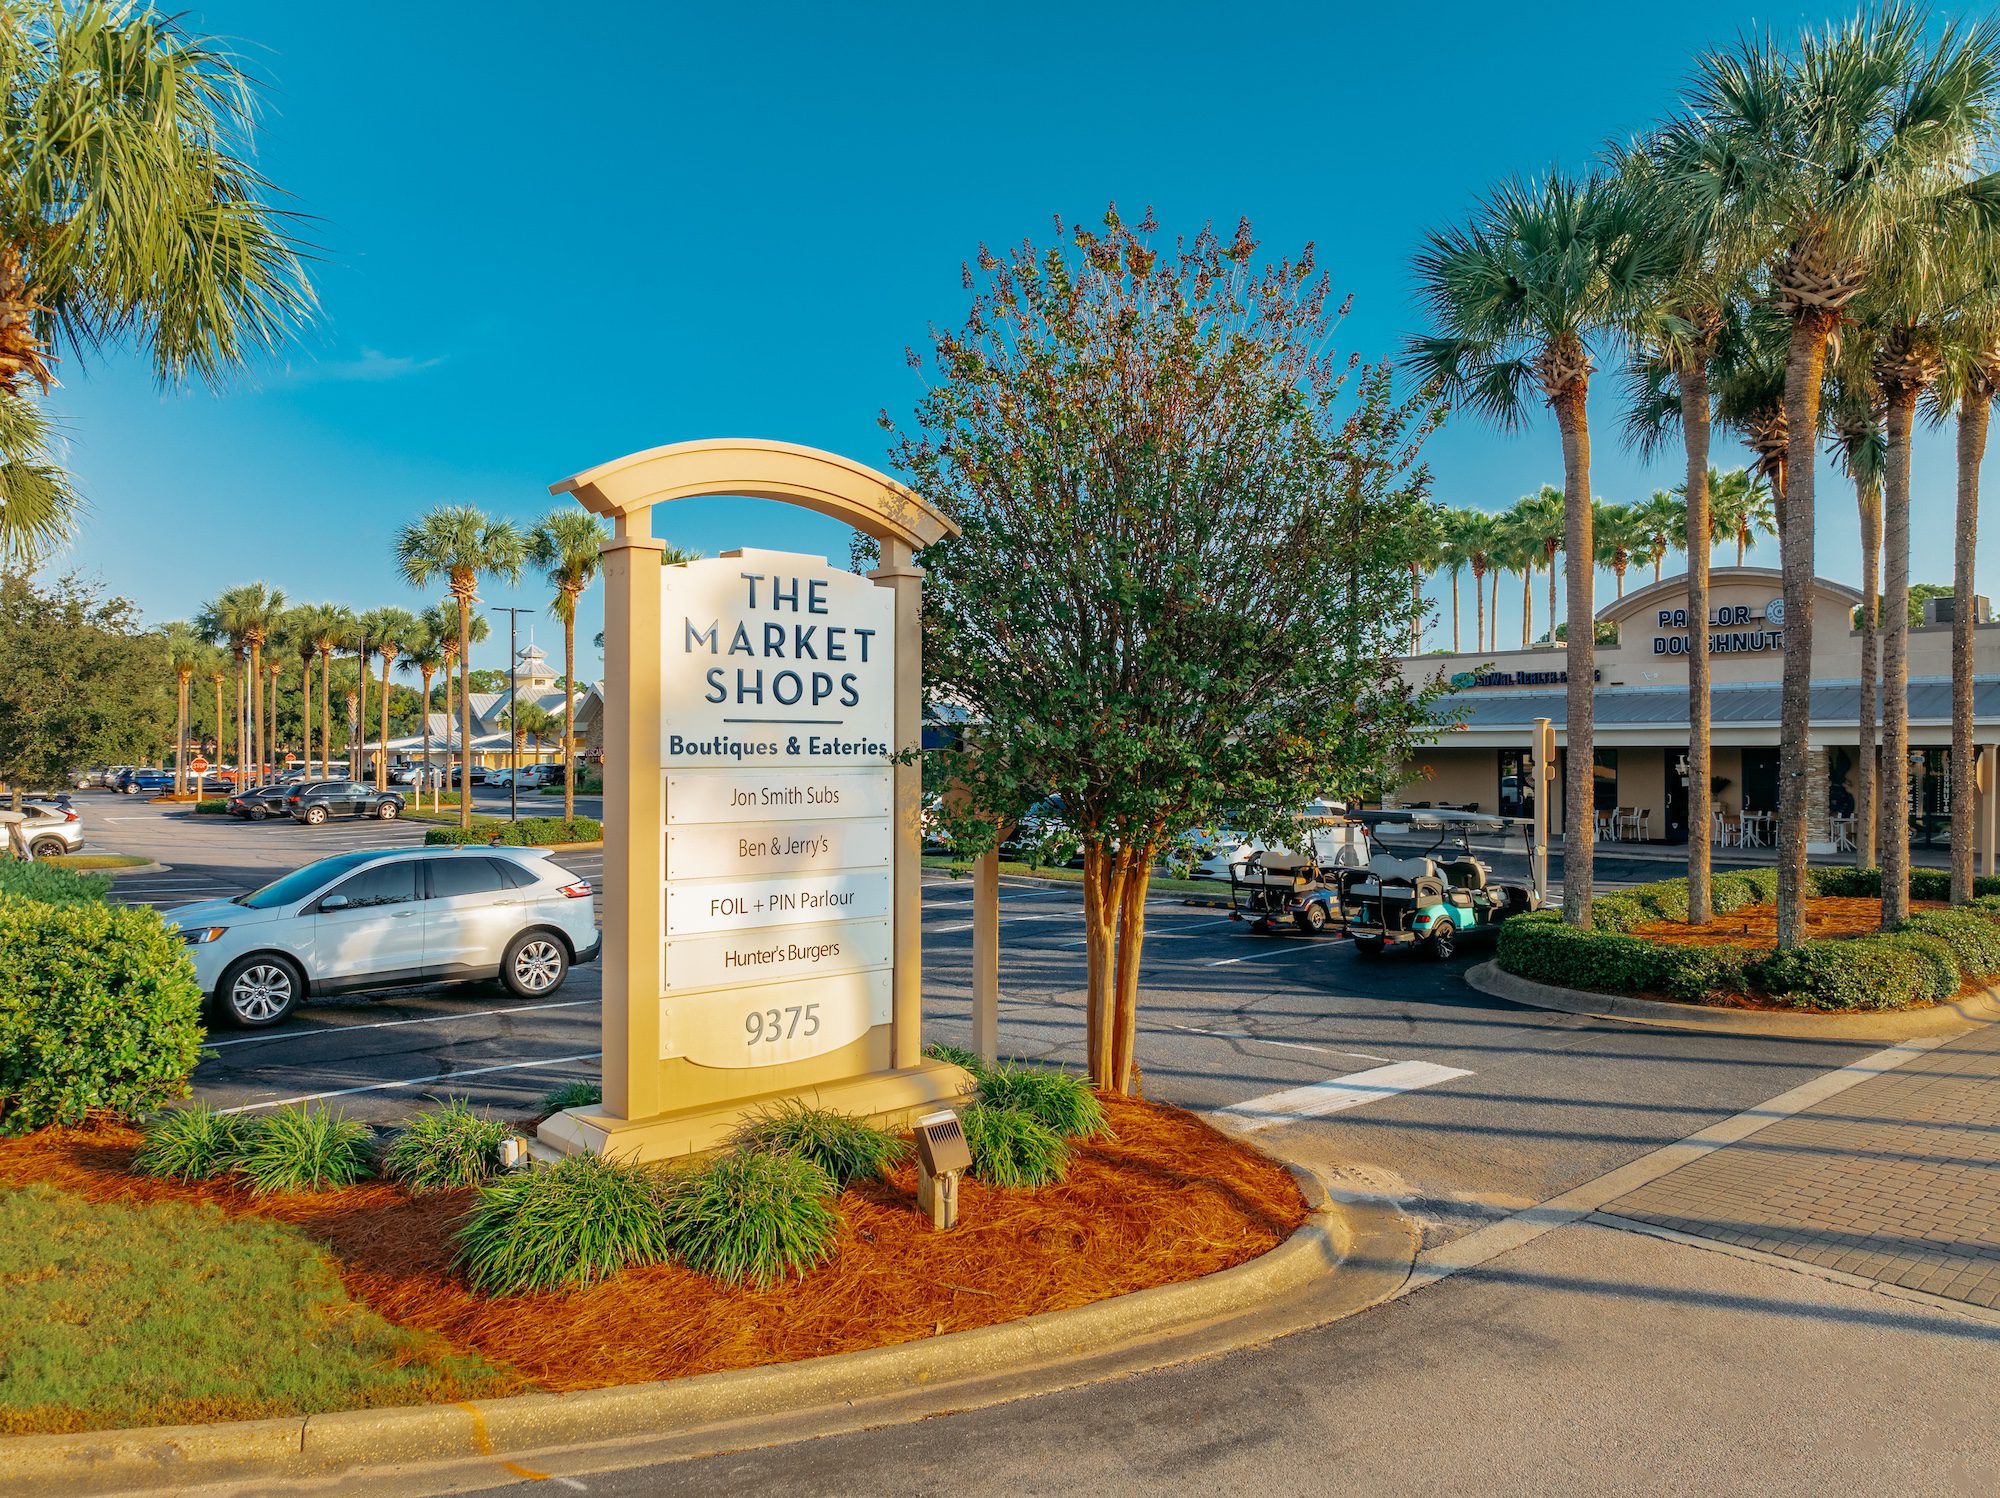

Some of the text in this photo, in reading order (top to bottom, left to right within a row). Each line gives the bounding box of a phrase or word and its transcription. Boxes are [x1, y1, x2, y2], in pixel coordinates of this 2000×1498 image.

[741, 572, 828, 614] THE
[1657, 604, 1751, 629] PALOR
[685, 617, 876, 662] MARKET
[704, 667, 859, 707] SHOPS
[670, 735, 887, 760] Boutiques & Eateries
[730, 786, 840, 806] Jon Smith Subs
[739, 835, 828, 857] Ben & Jerry's
[711, 890, 855, 916] FOIL + PIN Parlour
[725, 942, 840, 968] Hunter's Burgers
[745, 1003, 820, 1046] 9375
